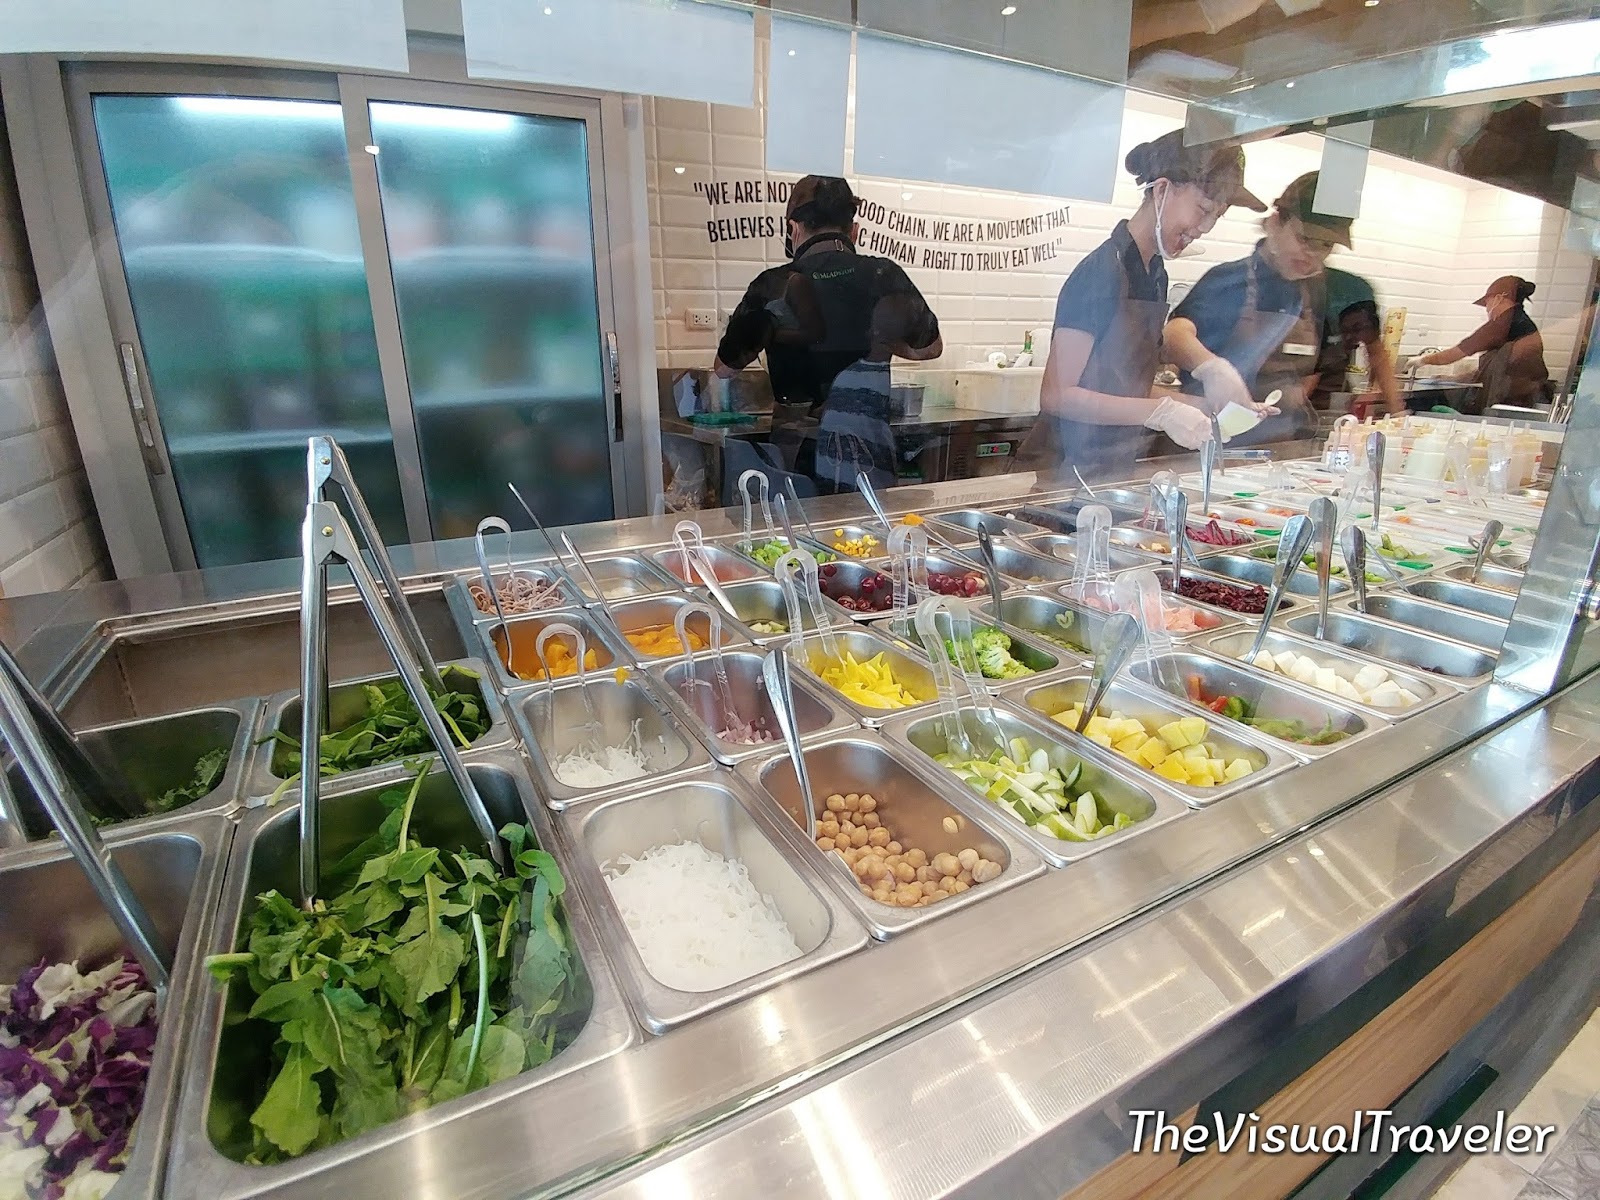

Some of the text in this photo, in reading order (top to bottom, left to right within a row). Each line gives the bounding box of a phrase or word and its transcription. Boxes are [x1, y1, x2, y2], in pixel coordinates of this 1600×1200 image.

[734, 181, 763, 204] ARE
[857, 198, 885, 225] OOD
[888, 210, 929, 239] CHAIN.
[933, 220, 951, 241] WE
[952, 223, 974, 242] ARE
[976, 223, 984, 242] A
[987, 214, 1044, 241] MOVEMENT
[1045, 206, 1070, 230] THAT
[707, 216, 775, 243] BELIEVES
[869, 231, 917, 265] HUMAN
[922, 248, 958, 271] RIGHT
[960, 252, 974, 272] TO
[976, 250, 1010, 271] TRULY
[1012, 247, 1030, 268] EAT
